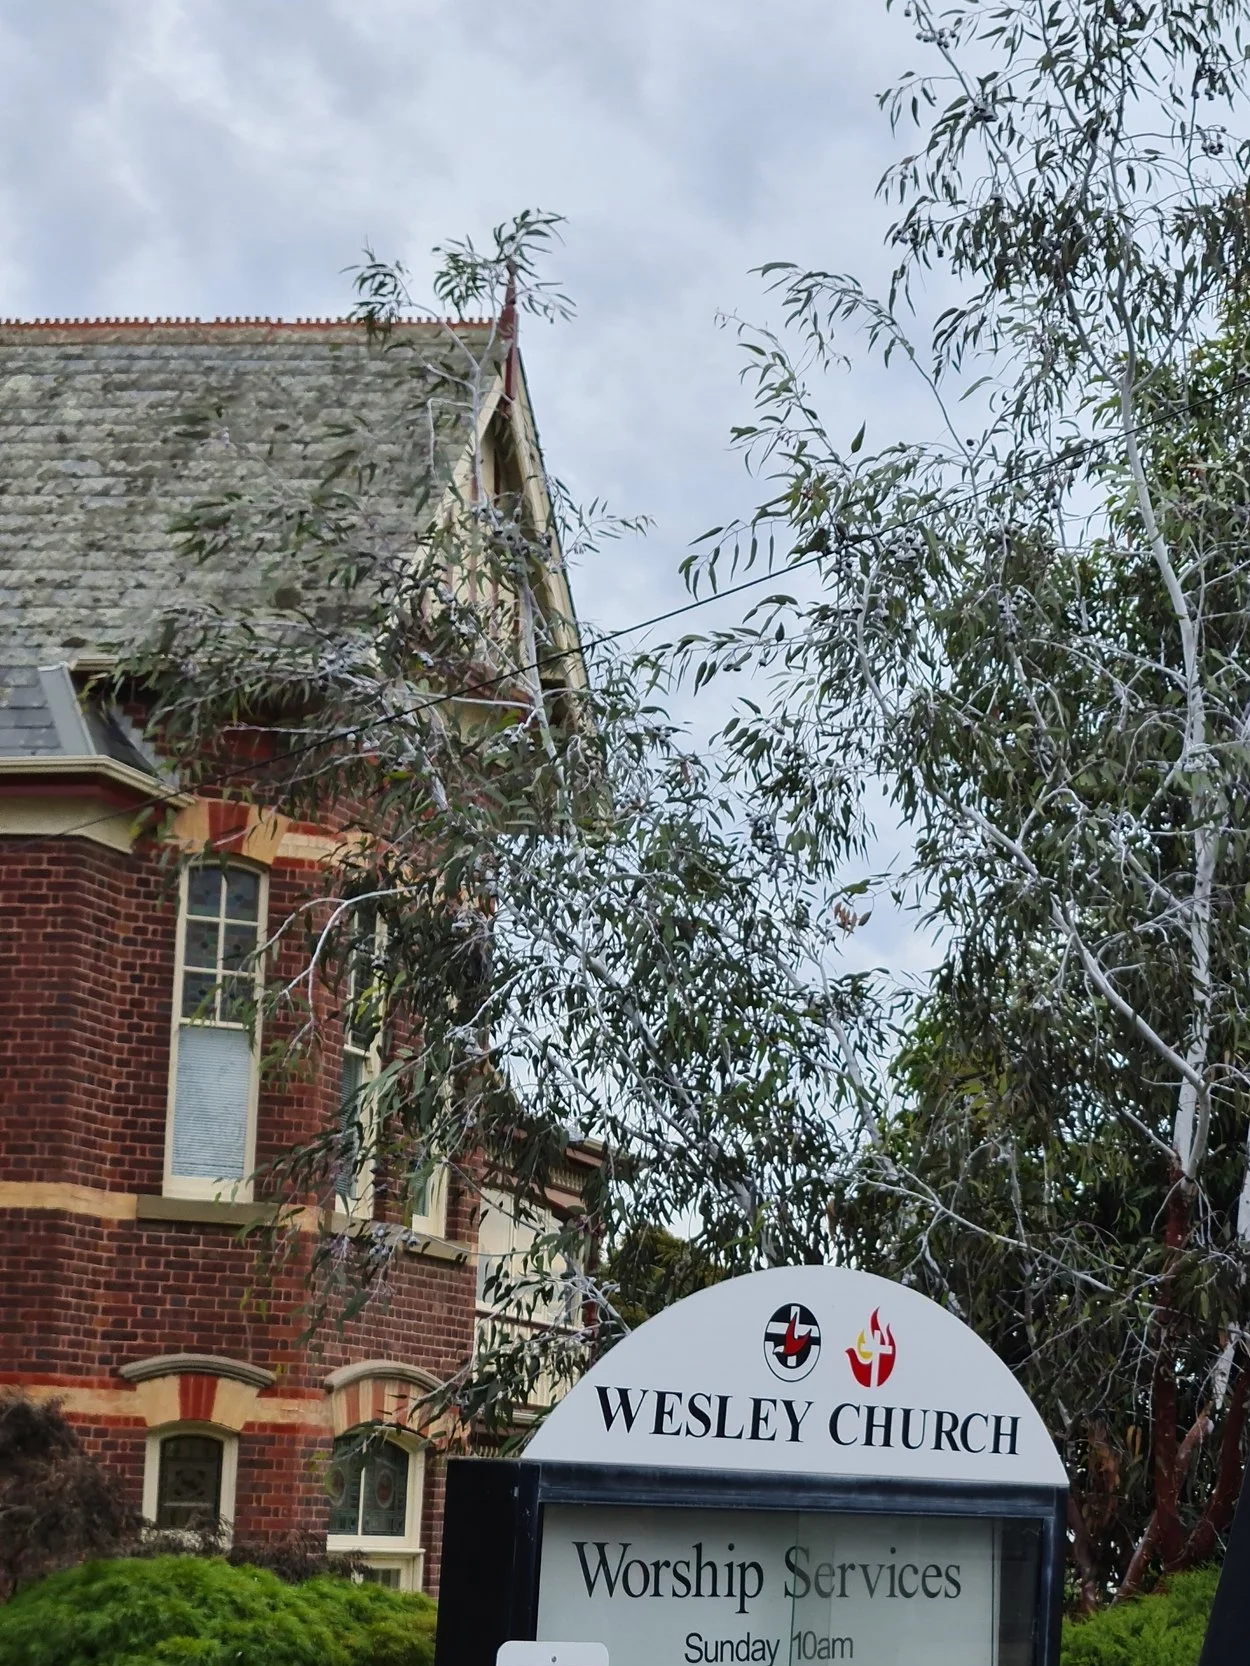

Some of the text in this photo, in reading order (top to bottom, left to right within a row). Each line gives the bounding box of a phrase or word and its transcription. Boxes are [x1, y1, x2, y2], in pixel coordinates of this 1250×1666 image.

[594, 1385, 1022, 1456] WESLEY CHURCH
[572, 1541, 962, 1614] Worship Services
[791, 1630, 854, 1660] 10am
